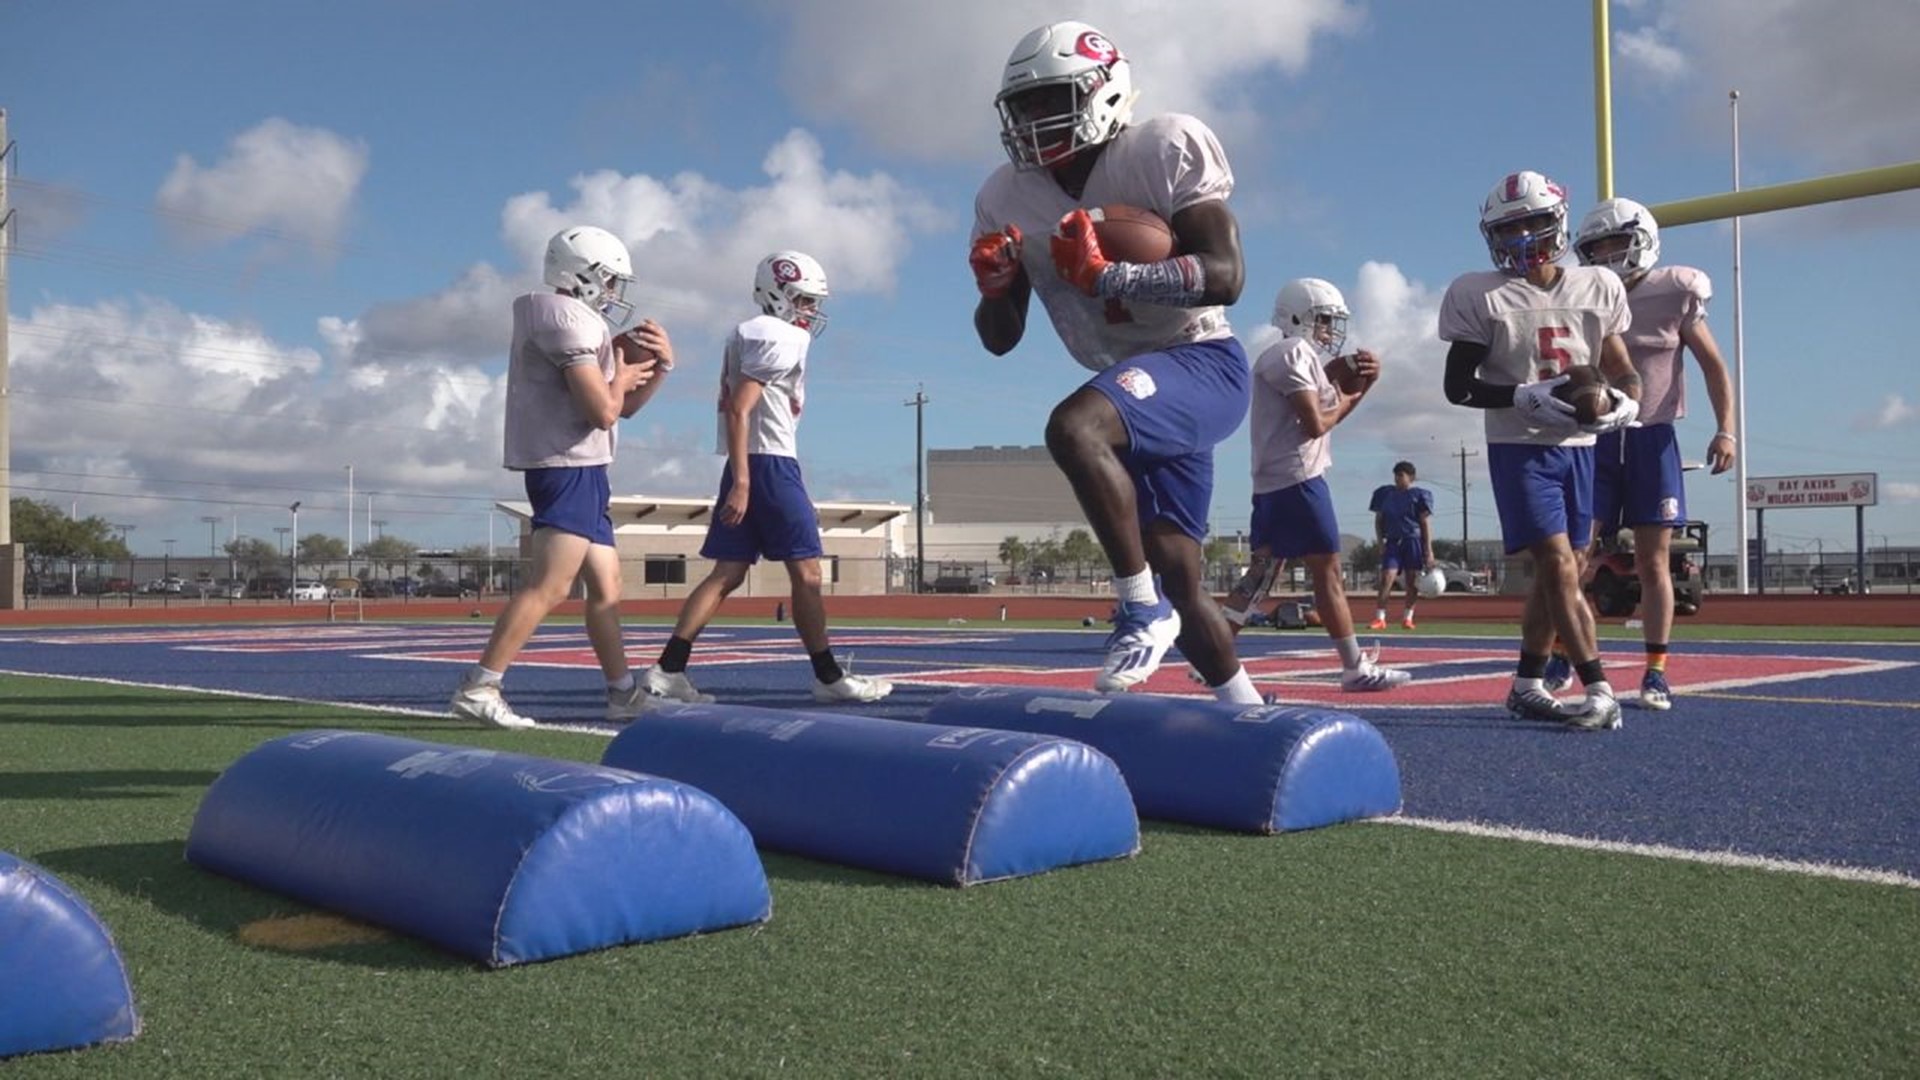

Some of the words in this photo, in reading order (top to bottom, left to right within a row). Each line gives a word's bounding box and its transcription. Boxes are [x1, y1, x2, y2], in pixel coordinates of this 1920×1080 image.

[1538, 327, 1572, 381] 5
[1778, 480, 1798, 491] RAY
[1803, 479, 1836, 489] AKINS
[1767, 493, 1806, 504] WILDCAT
[1808, 492, 1849, 503] STADIUM
